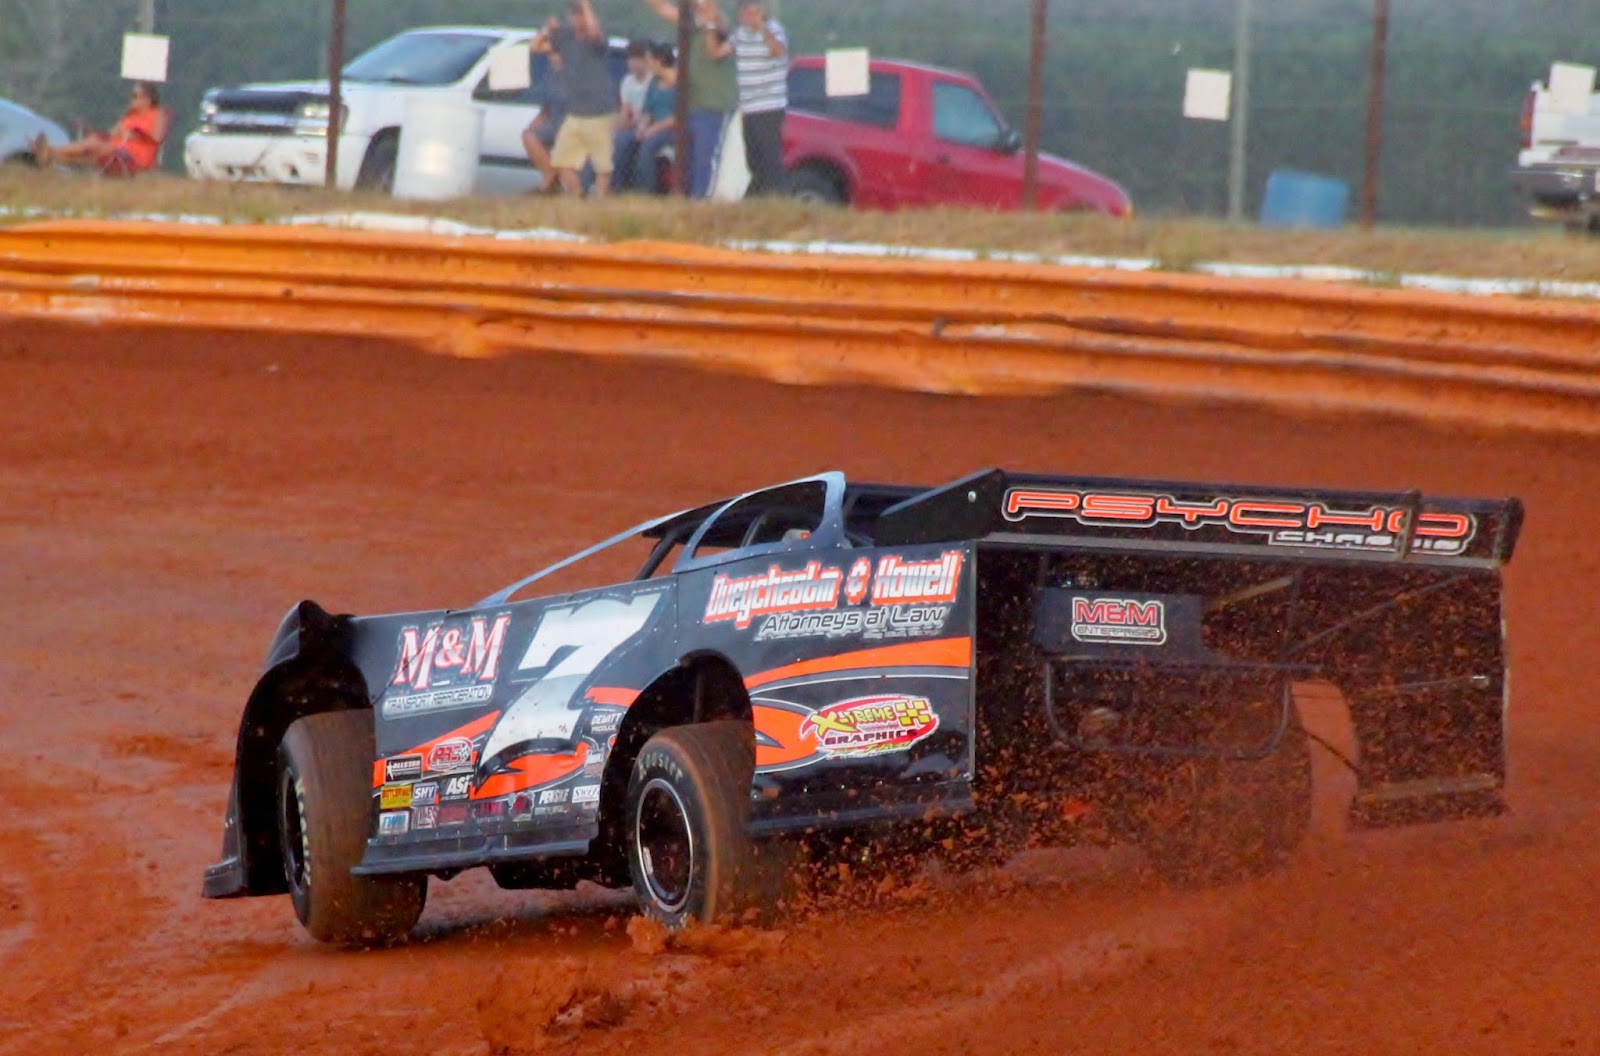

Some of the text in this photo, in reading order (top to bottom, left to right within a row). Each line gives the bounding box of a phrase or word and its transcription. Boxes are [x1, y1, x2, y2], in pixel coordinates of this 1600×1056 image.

[1007, 489, 1469, 538] PSYCHO
[845, 556, 872, 605] &
[871, 550, 963, 605] Howell
[757, 606, 949, 637] Attorneys at Law
[1076, 601, 1157, 625] M&M
[392, 615, 512, 690] M&M
[478, 591, 663, 768] 7
[824, 729, 919, 745] GRAPHICS
